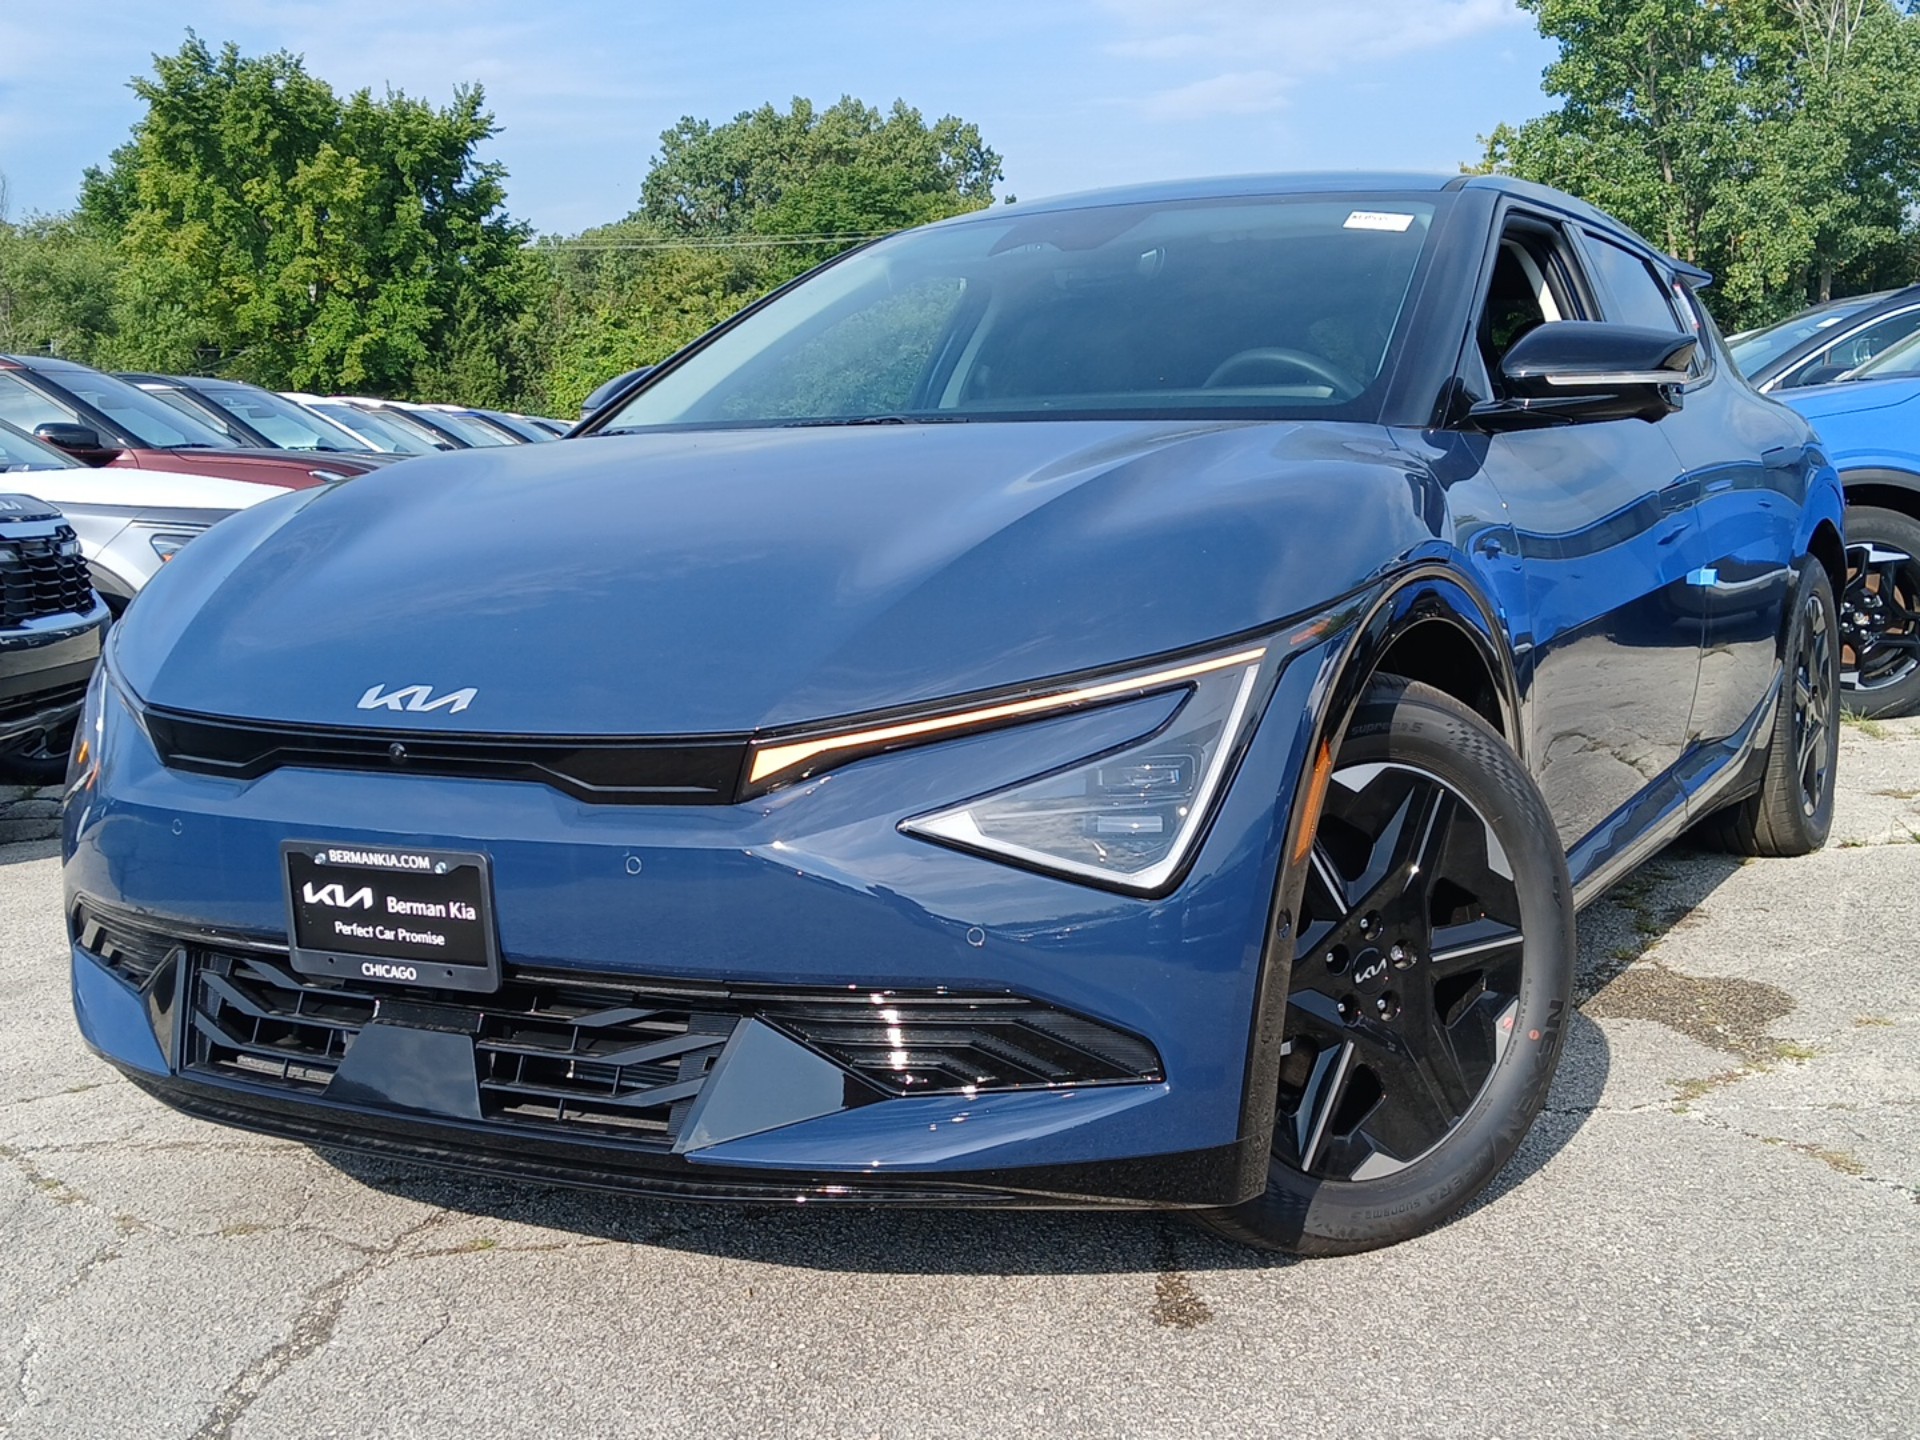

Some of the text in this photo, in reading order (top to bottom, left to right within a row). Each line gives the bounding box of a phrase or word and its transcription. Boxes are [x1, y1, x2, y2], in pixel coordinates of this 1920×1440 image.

[356, 683, 479, 714] KIA
[328, 849, 430, 870] BERMANKIA.COM
[386, 896, 477, 921] Berman Kia
[334, 921, 446, 946] Perfect Car Promise
[361, 962, 417, 981] CHICAGO
